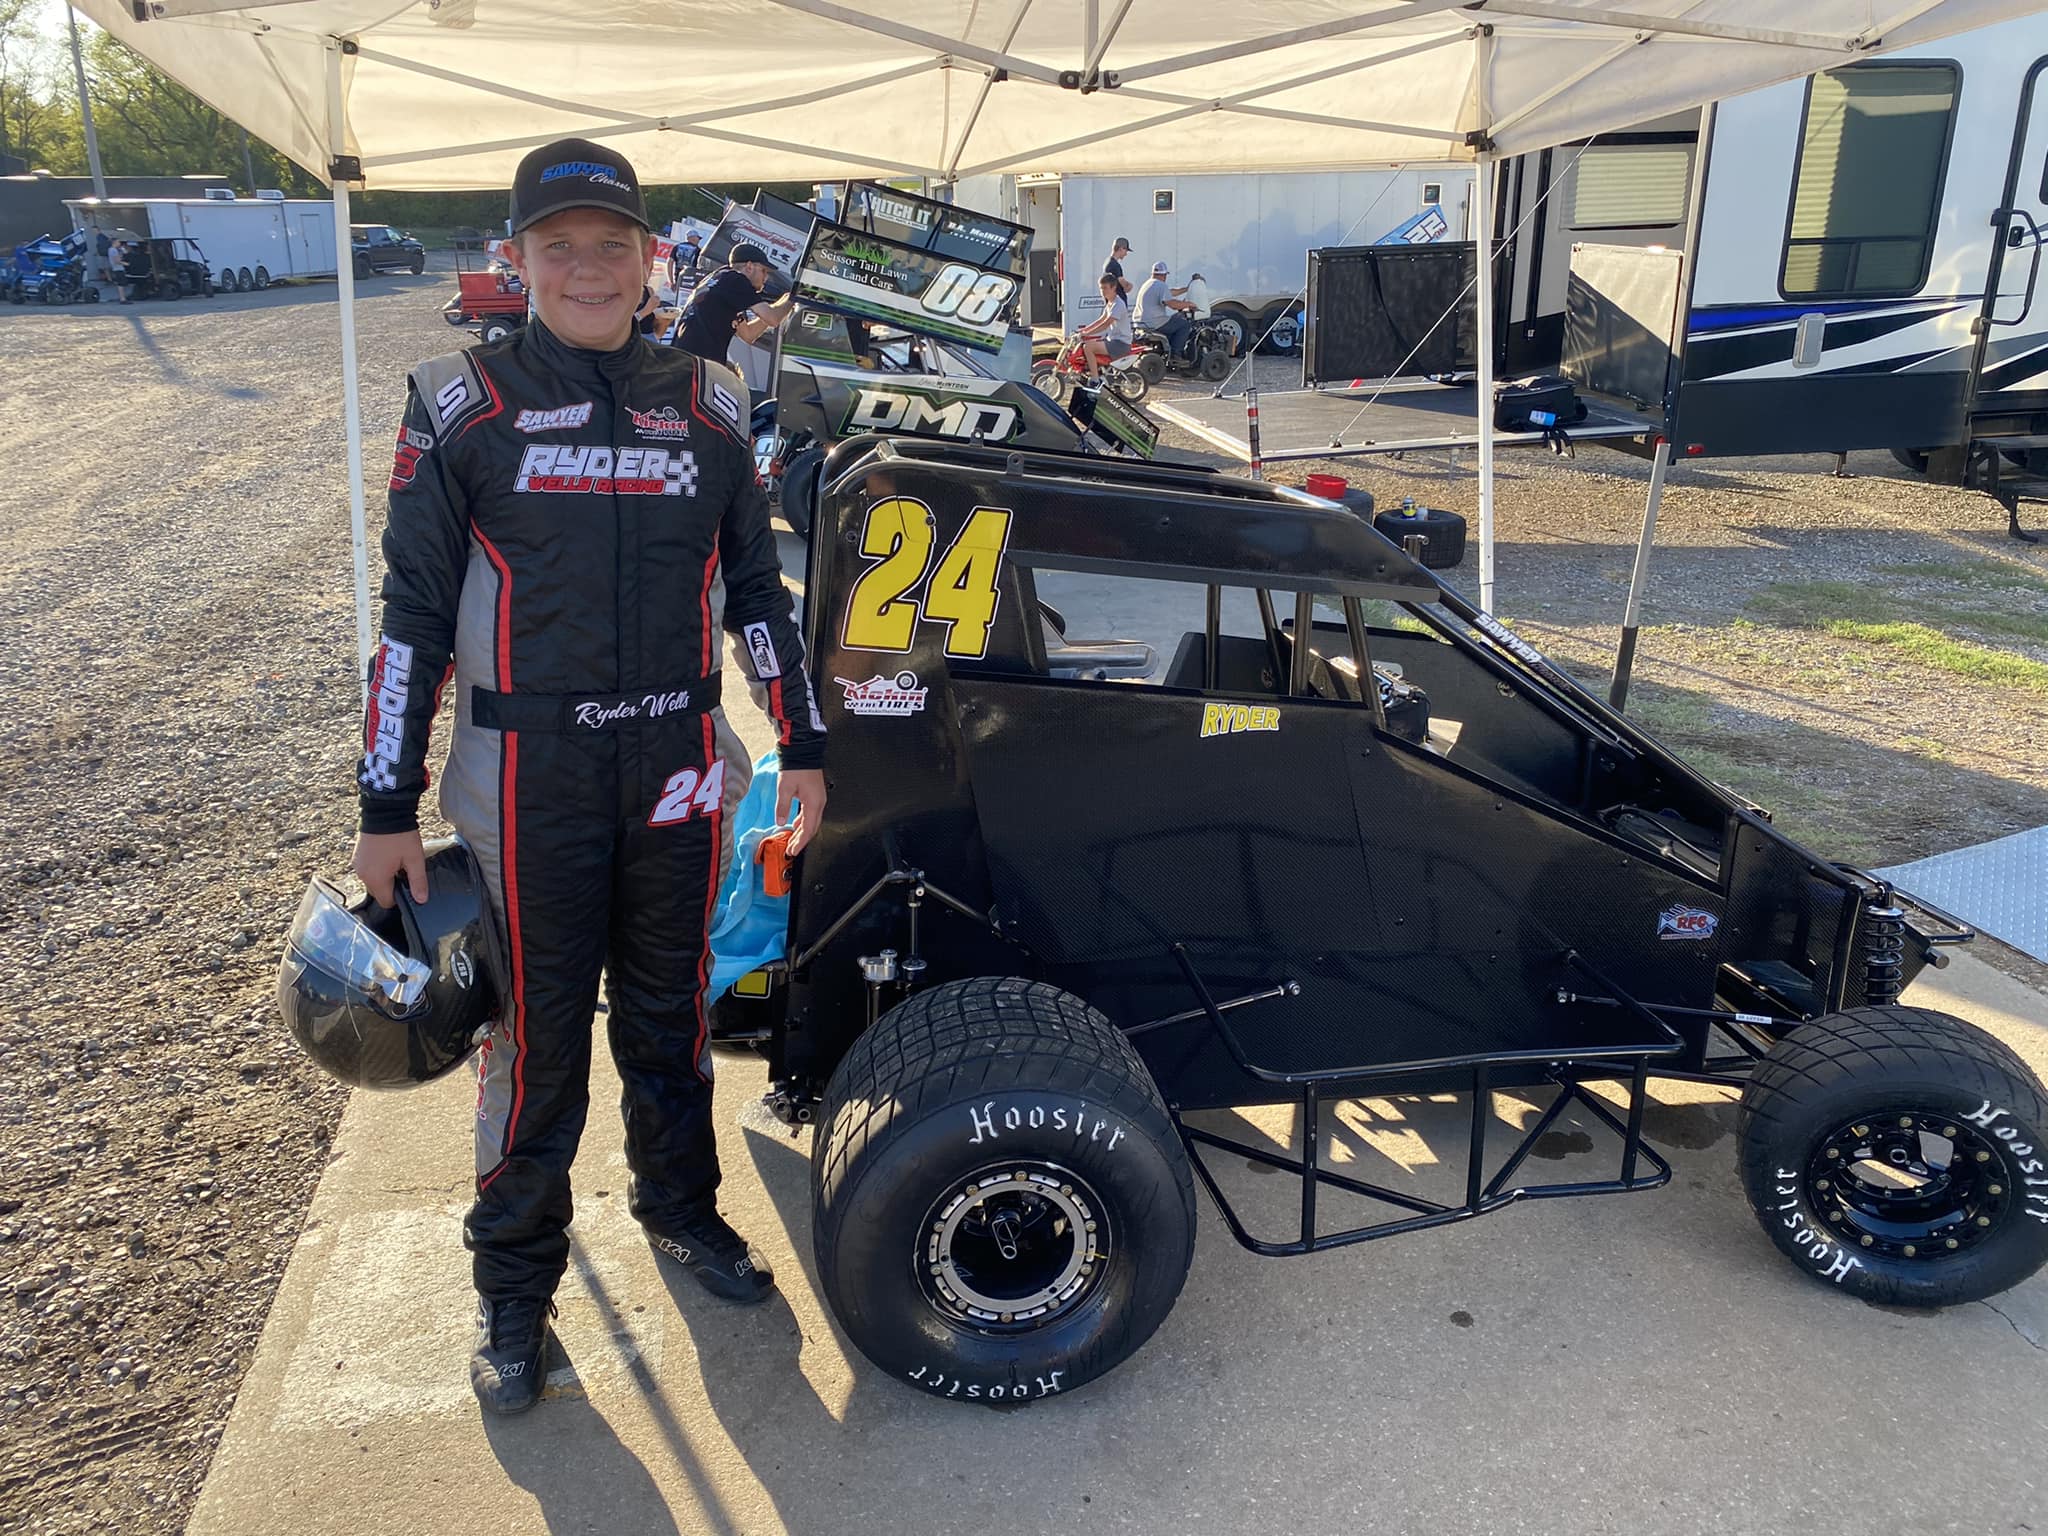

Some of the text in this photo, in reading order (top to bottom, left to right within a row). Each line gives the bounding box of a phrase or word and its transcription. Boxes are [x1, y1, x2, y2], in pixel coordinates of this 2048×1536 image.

[541, 162, 617, 182] SAWYER
[588, 172, 632, 192] Chassis
[916, 208, 932, 224] IT
[970, 228, 1017, 247] McINTOH
[820, 249, 908, 281] Scissor Tail Lawn
[829, 265, 894, 290] & Land Care
[921, 262, 1017, 326] 08
[517, 402, 591, 428] SAWYER
[850, 389, 1016, 440] DMD
[1120, 407, 1140, 426] MILLER
[521, 446, 667, 479] RYDER
[528, 477, 664, 493] WELLS RACING
[842, 496, 1013, 660] 24
[1474, 613, 1543, 663] SAWYER
[373, 638, 413, 764] RYDER
[575, 691, 690, 729] Ryder Wells
[1200, 703, 1281, 737] RYDER
[647, 758, 725, 826] 24
[969, 1101, 1126, 1151] Hoosier
[1958, 1100, 2048, 1224] Hoosier
[1776, 1168, 1864, 1283] Hoosier
[908, 1366, 1064, 1399] Hoosier
